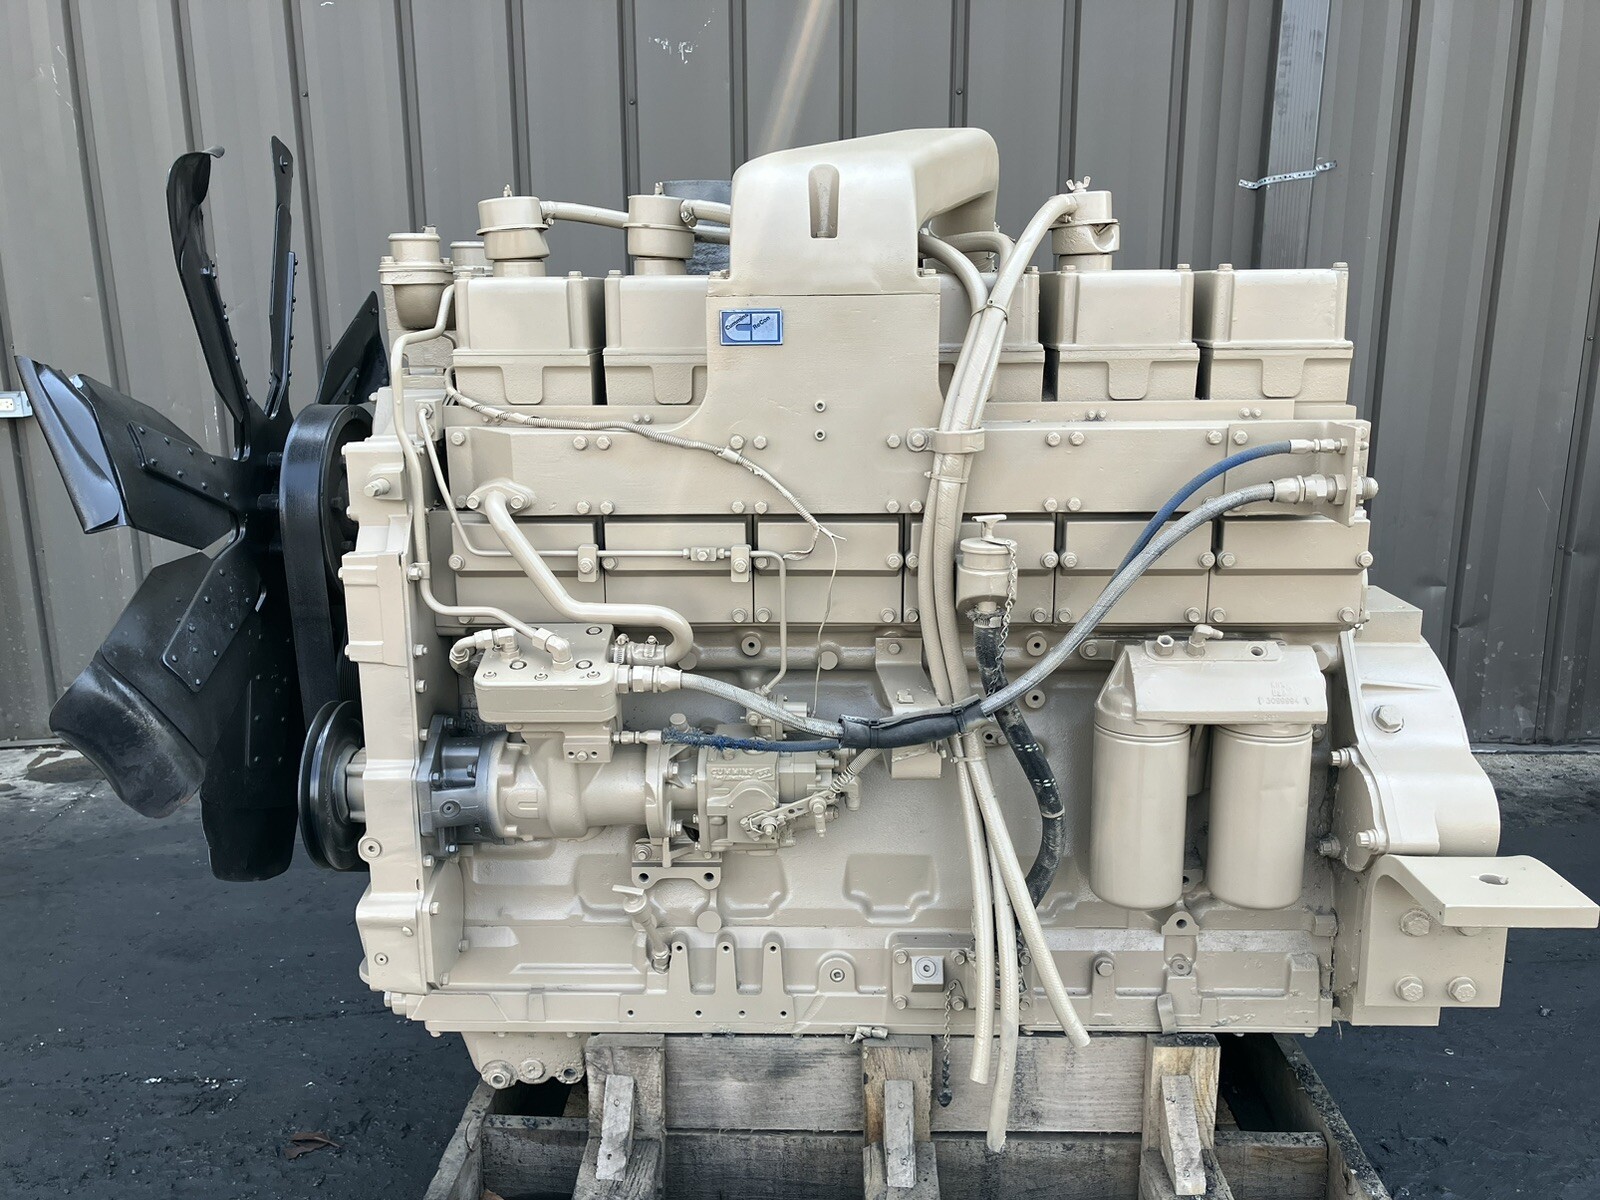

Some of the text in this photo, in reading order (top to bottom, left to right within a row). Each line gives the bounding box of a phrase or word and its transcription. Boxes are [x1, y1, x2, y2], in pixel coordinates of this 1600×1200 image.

[724, 313, 749, 330] Cummins
[752, 316, 771, 330] ReCon
[711, 767, 755, 776] CUMMINS
